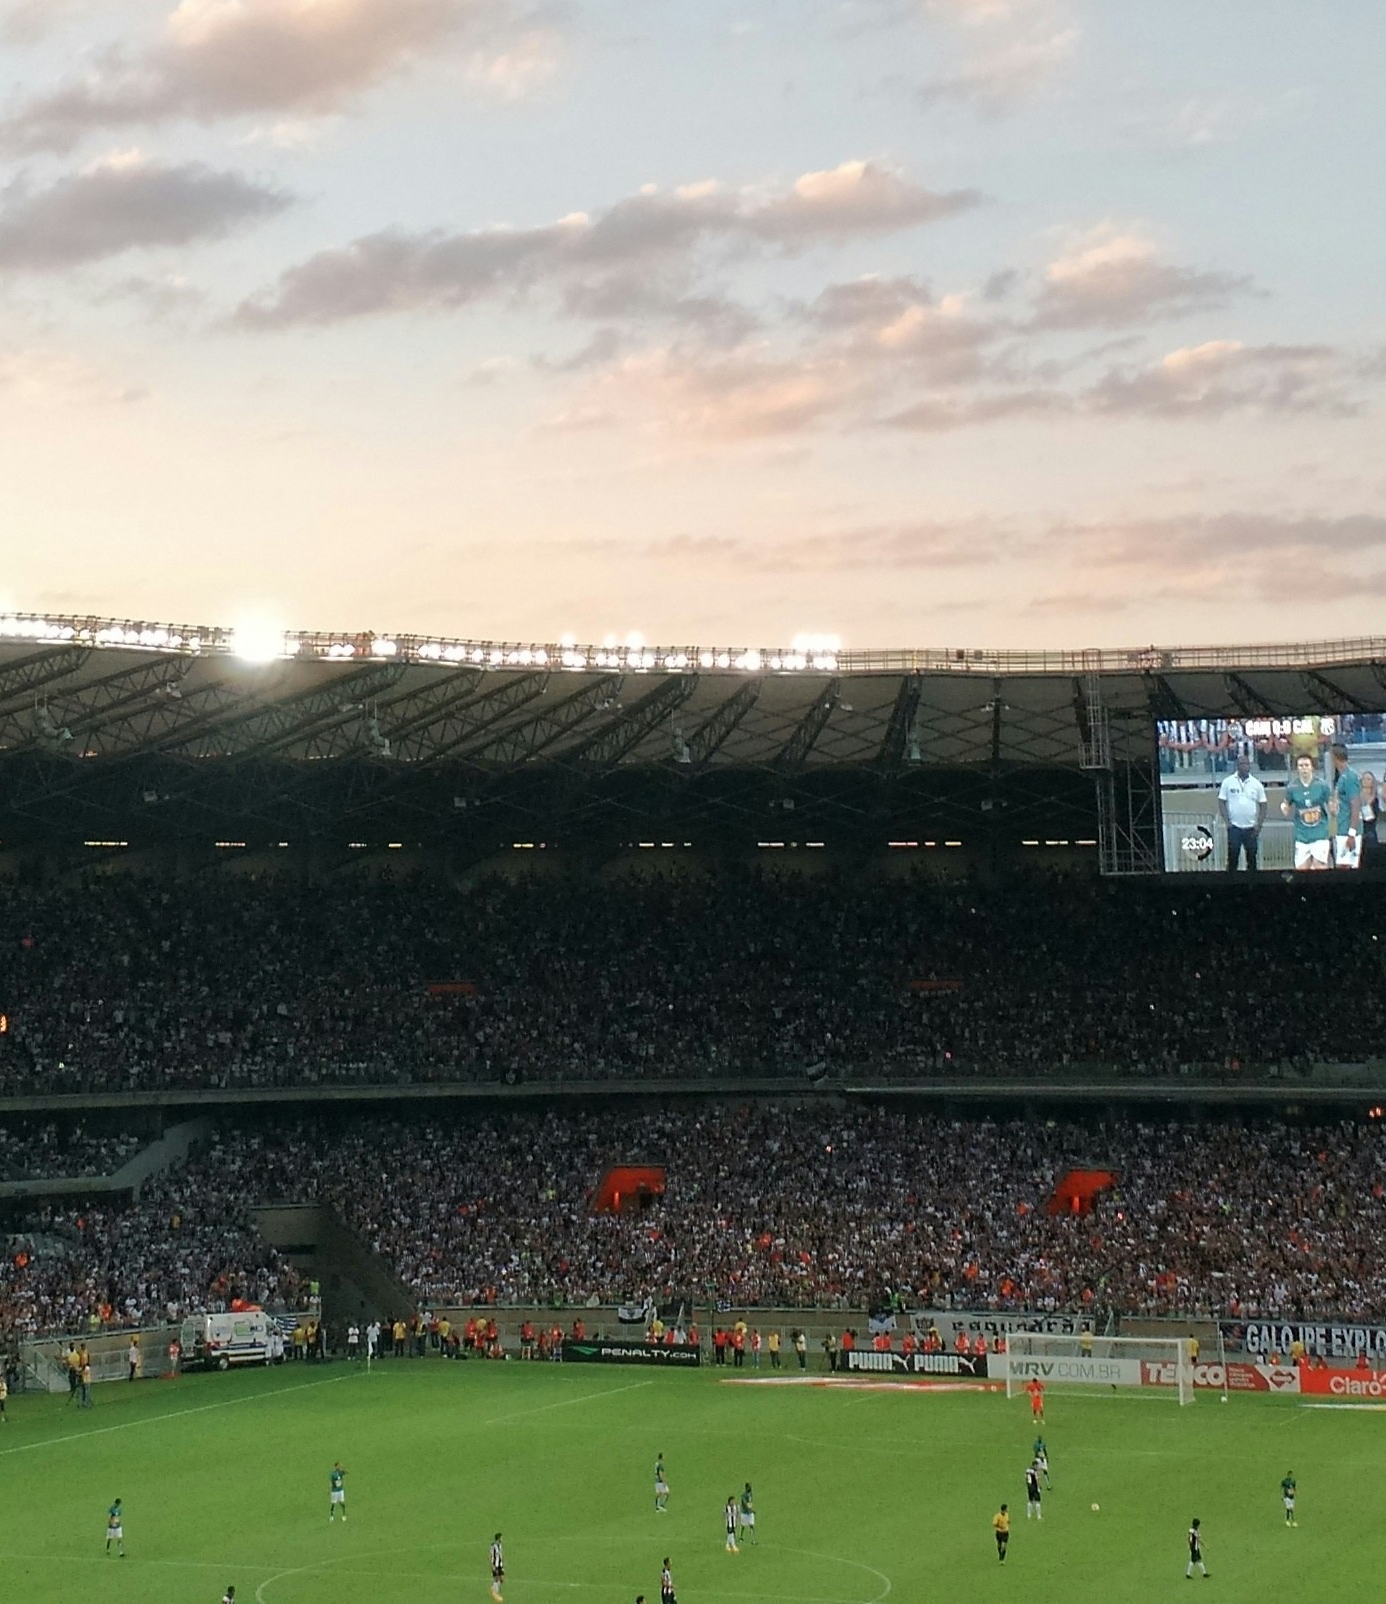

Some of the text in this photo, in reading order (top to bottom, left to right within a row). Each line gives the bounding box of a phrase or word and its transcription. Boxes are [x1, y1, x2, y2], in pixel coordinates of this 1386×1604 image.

[1181, 837, 1214, 850] 23:04
[1246, 1324, 1294, 1354] GALO
[848, 1352, 893, 1371] PUMA
[914, 1354, 959, 1373] PUMA
[1009, 1361, 1055, 1376] MRV
[1146, 1362, 1226, 1386] TENCO
